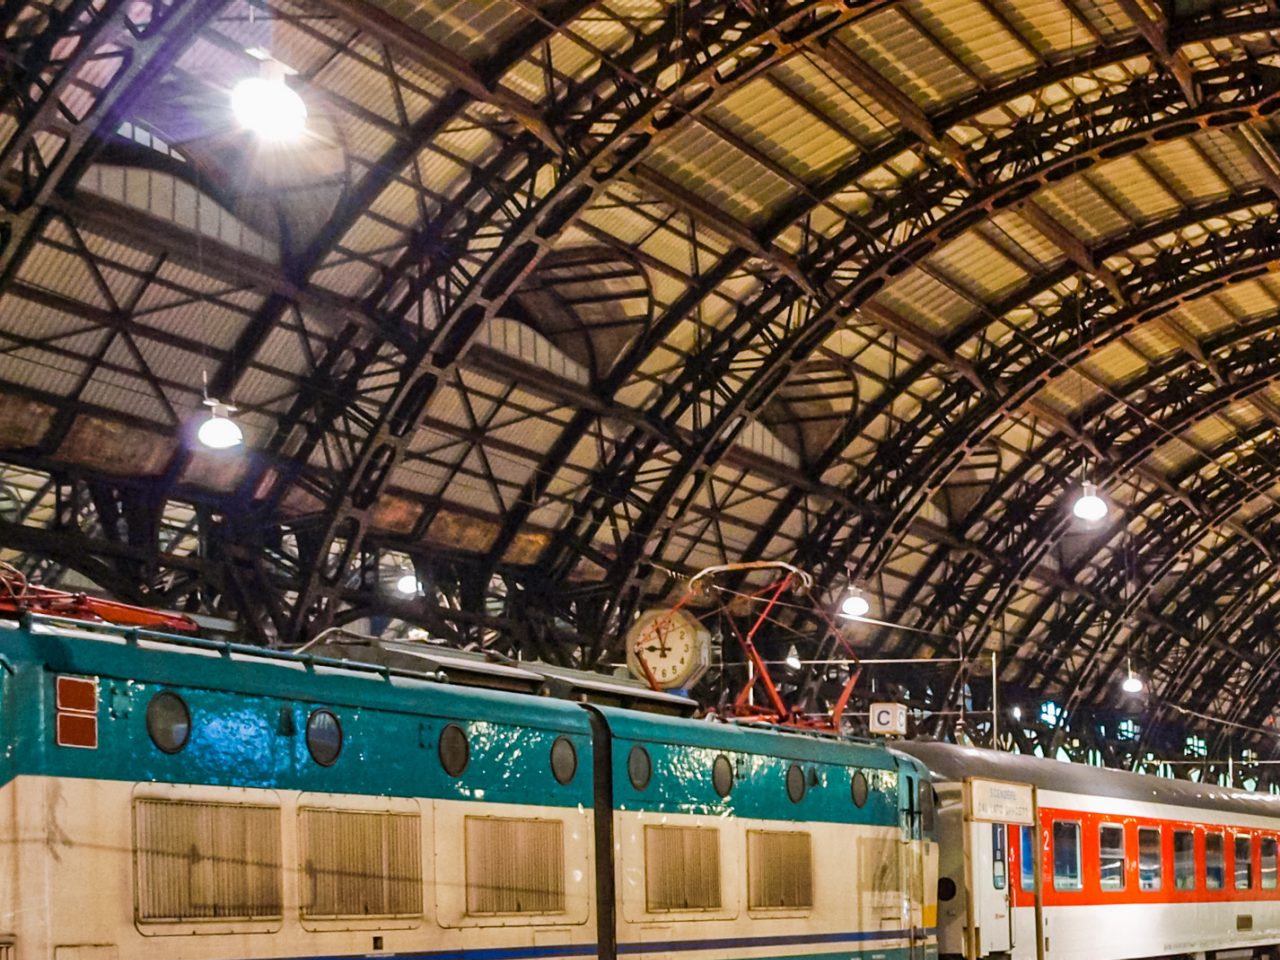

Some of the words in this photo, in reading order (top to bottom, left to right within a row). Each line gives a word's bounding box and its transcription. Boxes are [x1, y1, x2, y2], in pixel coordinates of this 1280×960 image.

[680, 631, 686, 640] 2
[684, 644, 689, 653] 3
[680, 657, 685, 665] 4
[652, 667, 657, 675] 7
[661, 669, 667, 678] 6
[672, 666, 677, 675] 5
[877, 710, 890, 726] C
[1043, 830, 1050, 851] 2
